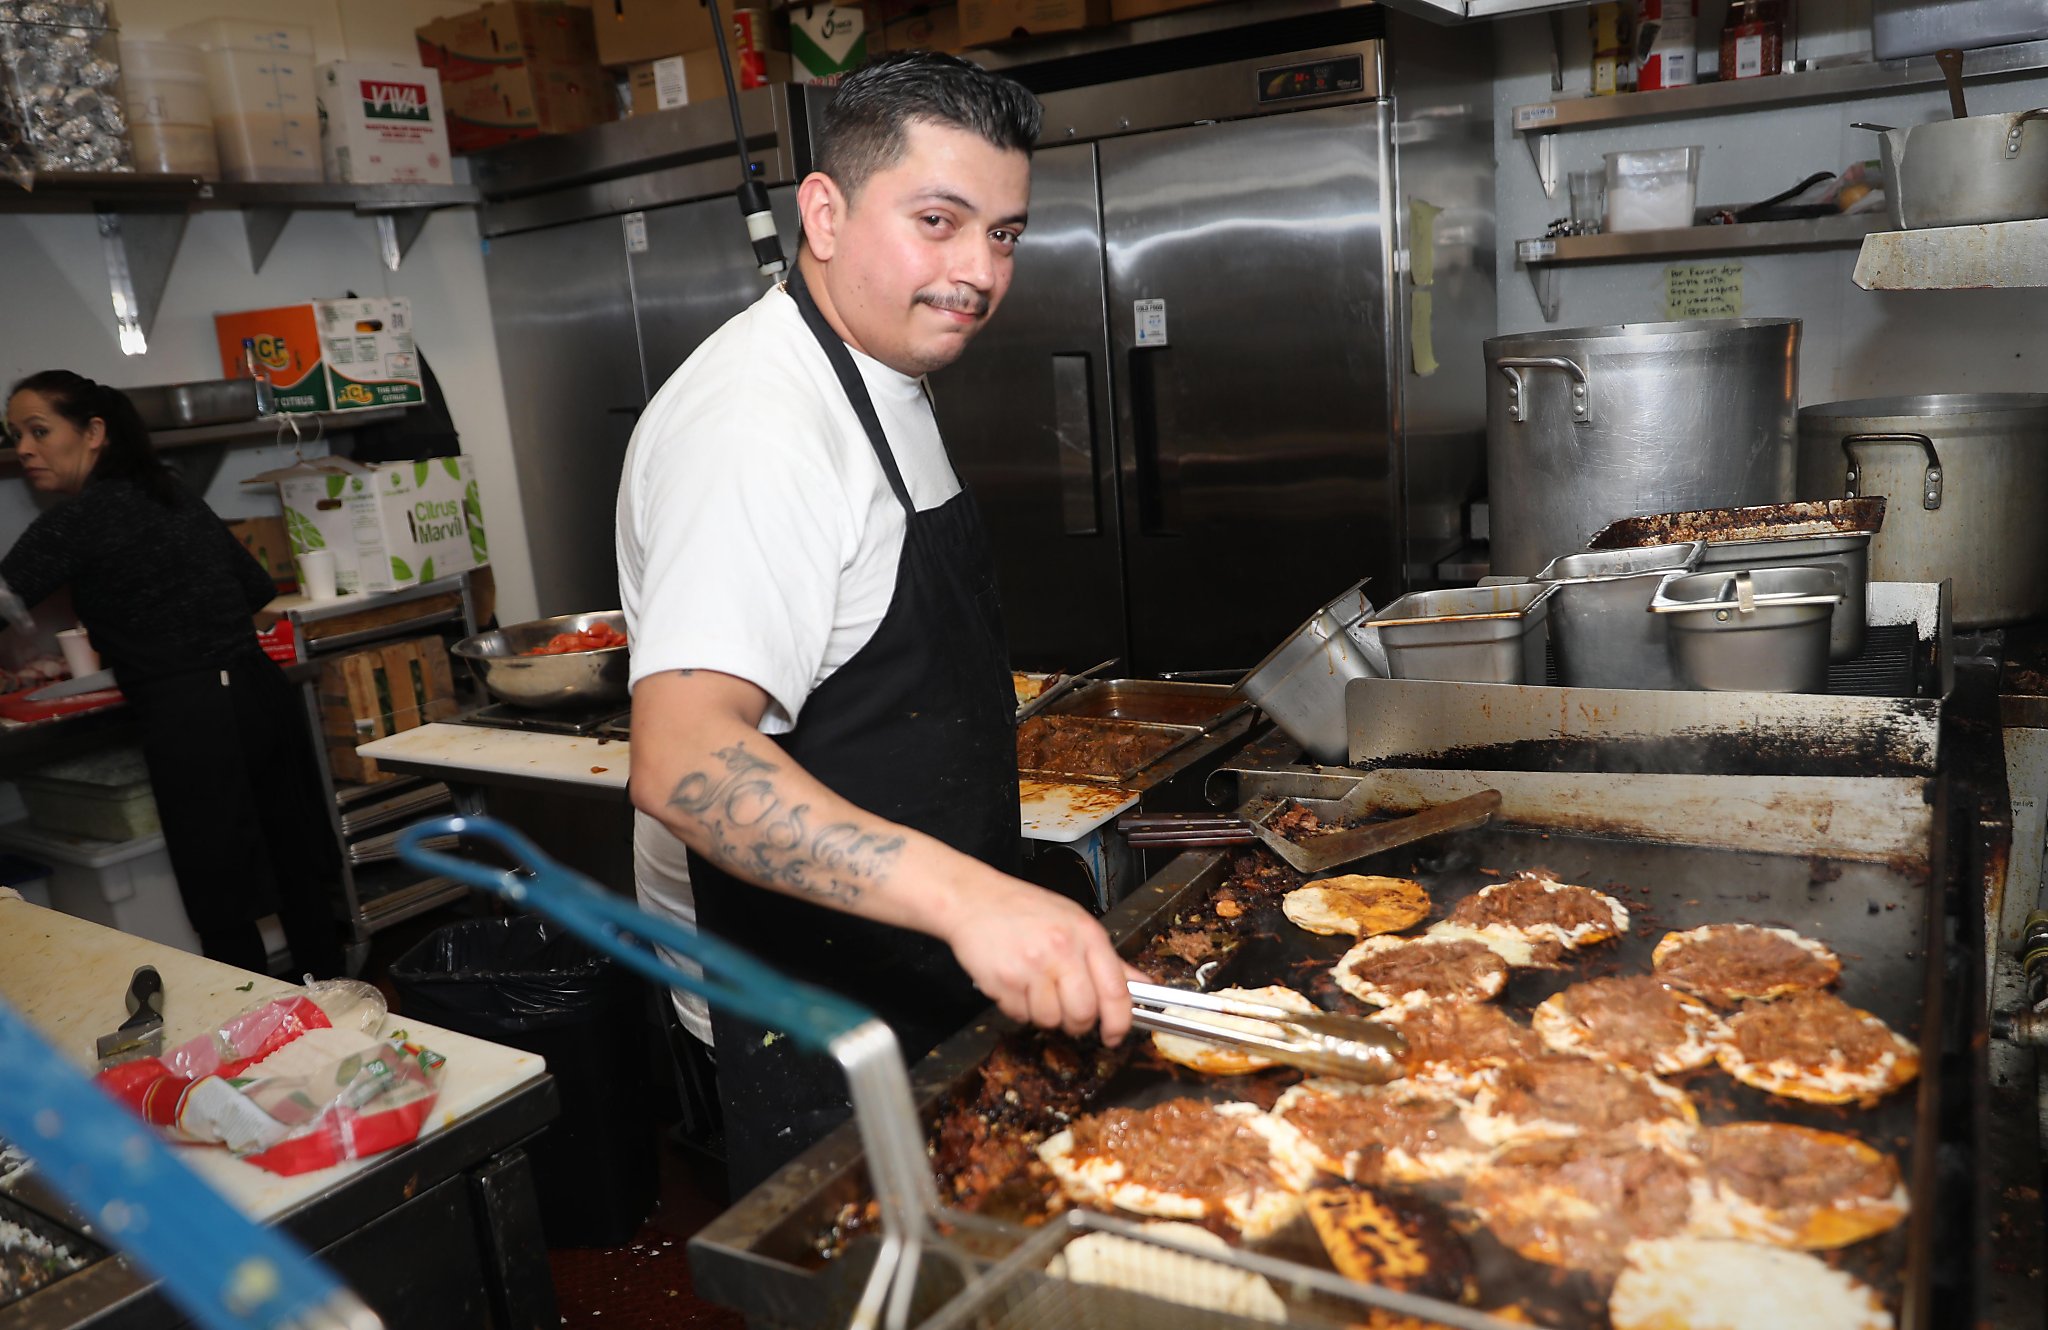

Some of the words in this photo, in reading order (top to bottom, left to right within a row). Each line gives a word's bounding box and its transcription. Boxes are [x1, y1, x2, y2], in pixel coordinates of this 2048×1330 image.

[370, 84, 420, 115] VIVA
[280, 395, 315, 407] CITRUS
[415, 501, 459, 522] Citrus
